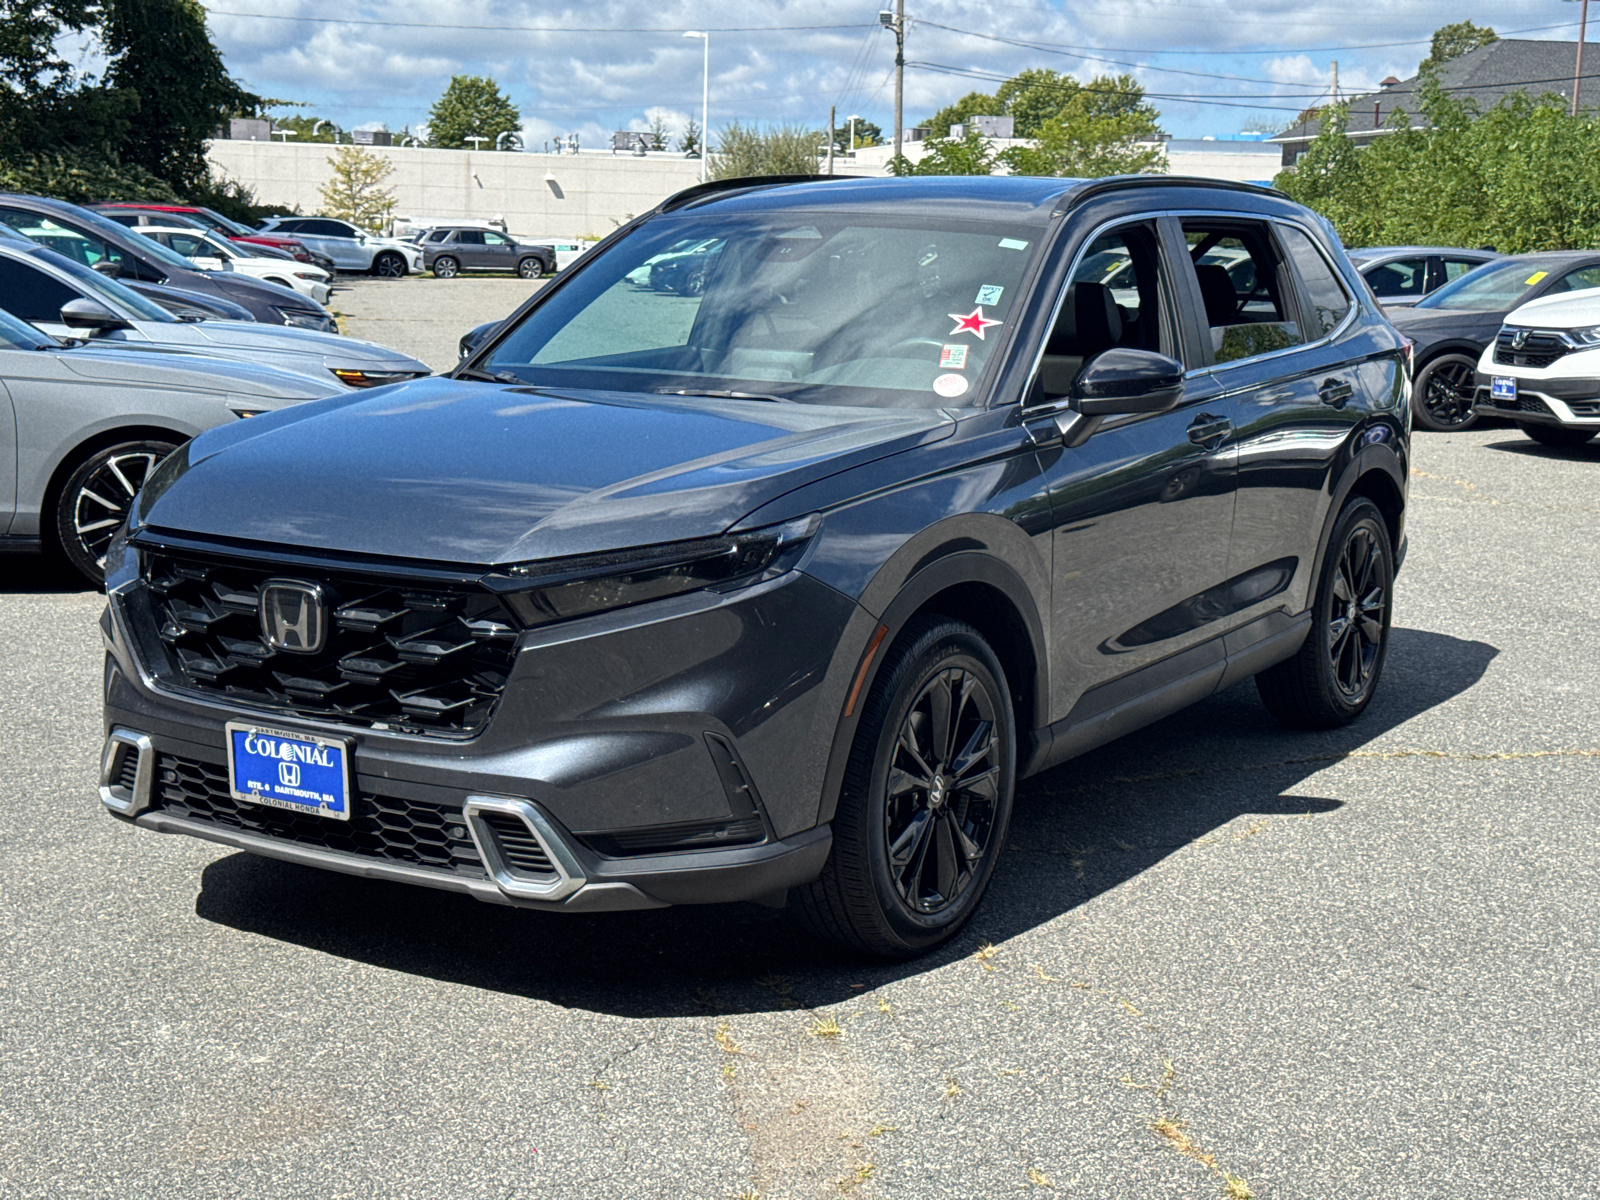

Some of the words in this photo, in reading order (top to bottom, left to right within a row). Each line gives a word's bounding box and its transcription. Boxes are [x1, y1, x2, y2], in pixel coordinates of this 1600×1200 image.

[245, 737, 334, 767] COLONIAL
[259, 797, 293, 809] COLONIAL
[295, 804, 320, 814] HONDA
[322, 793, 335, 803] MA
